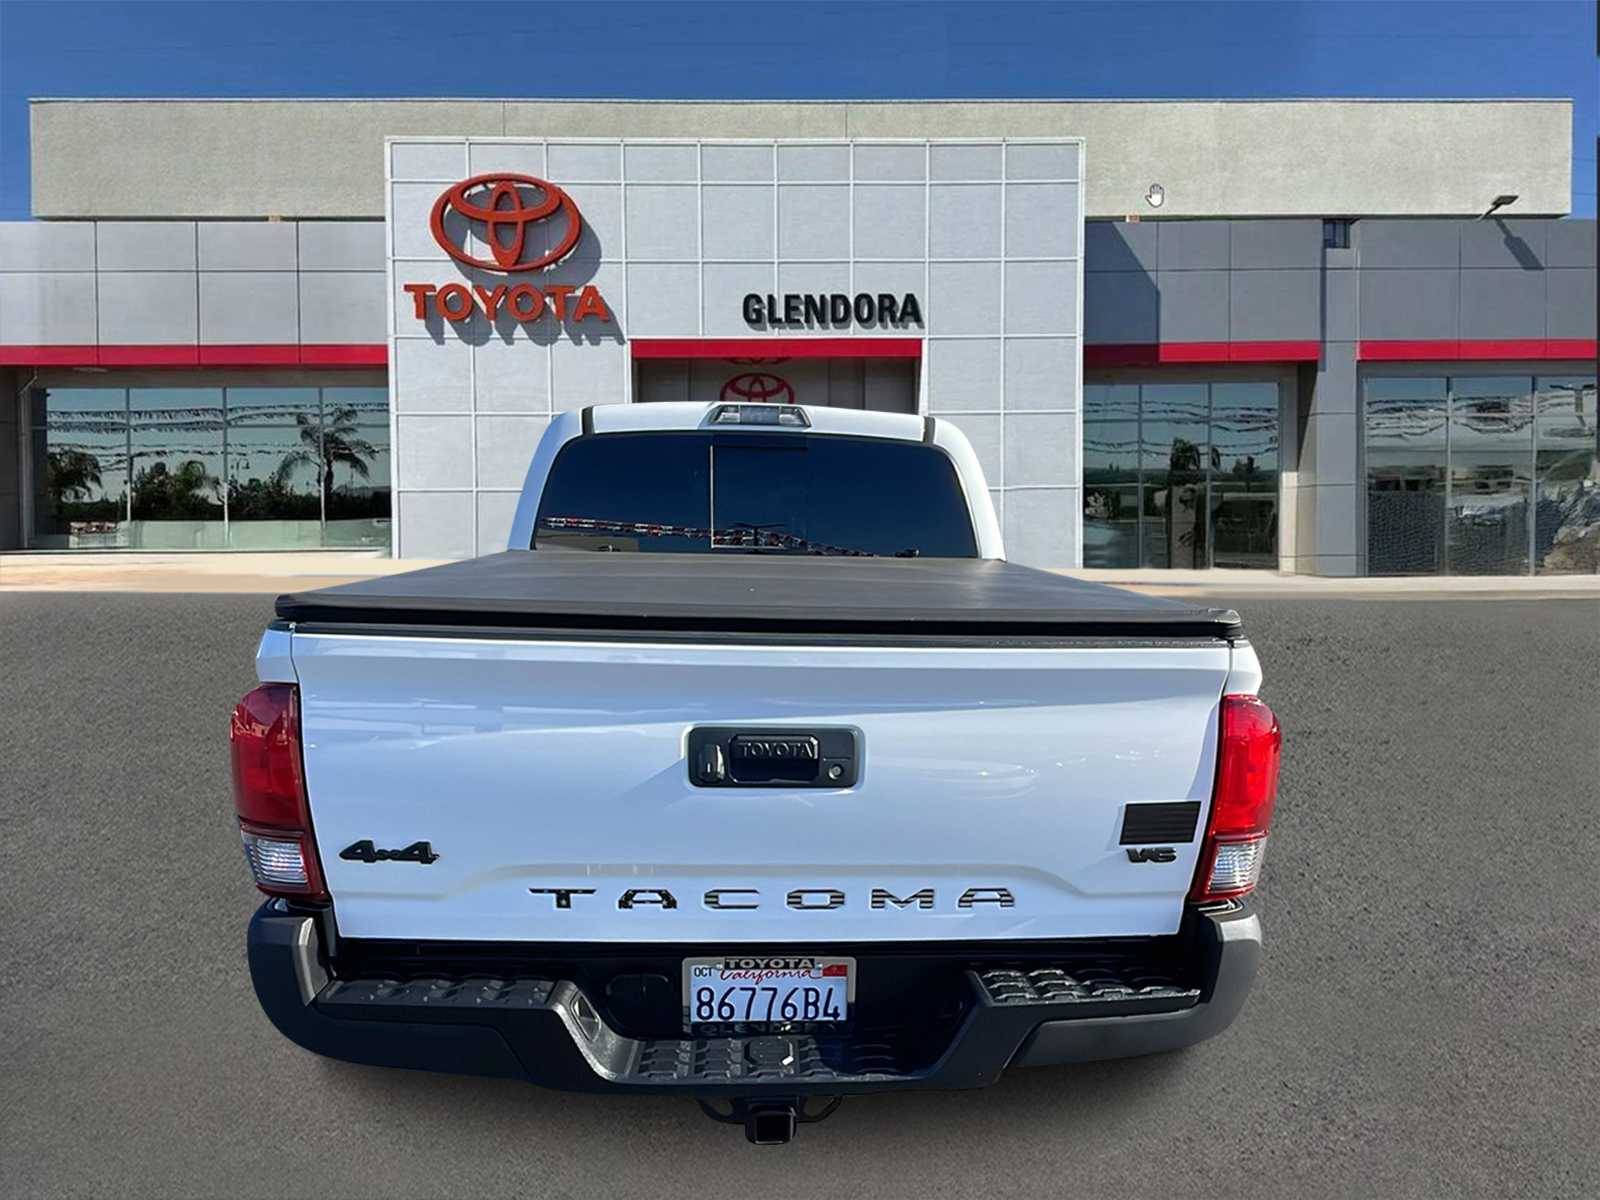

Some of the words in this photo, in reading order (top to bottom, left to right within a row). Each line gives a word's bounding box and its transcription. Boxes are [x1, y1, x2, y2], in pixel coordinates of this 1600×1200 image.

[403, 283, 610, 323] TOYOTA
[742, 293, 923, 327] GLENDORA
[739, 741, 814, 757] TOYOTA
[1126, 847, 1177, 863] V6
[528, 887, 1016, 910] TACOMA
[693, 966, 713, 977] OCT
[725, 958, 814, 969] TOYOTA
[696, 986, 841, 1021] 86776B4
